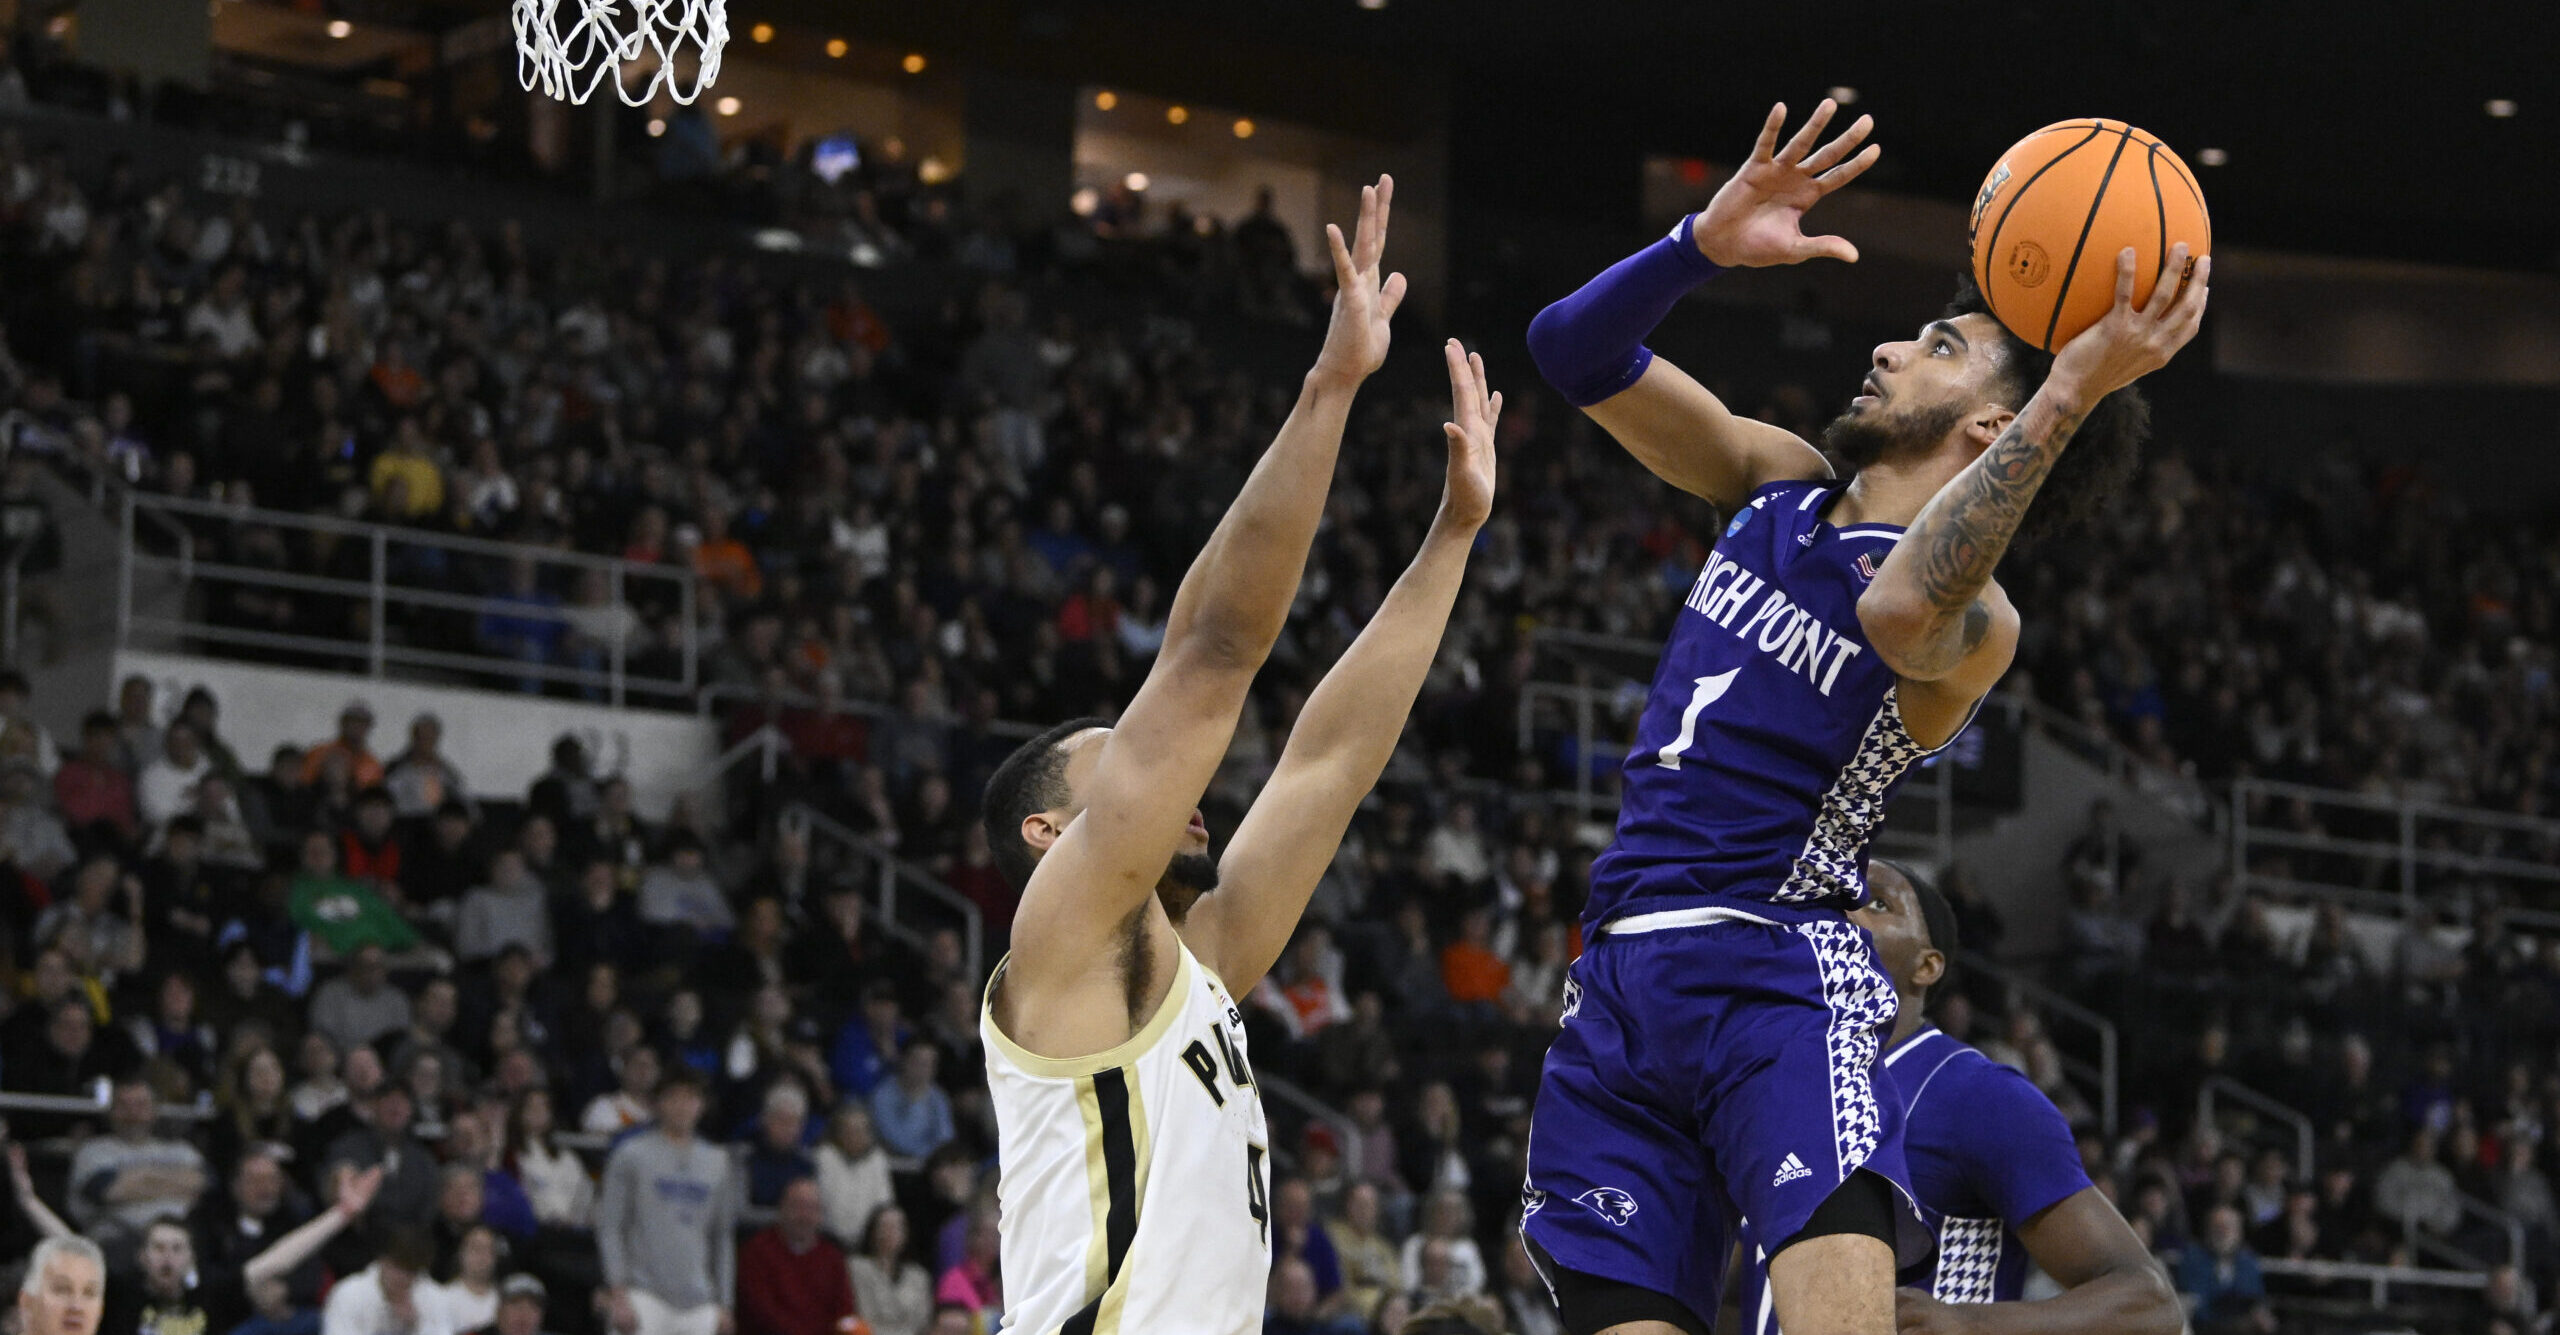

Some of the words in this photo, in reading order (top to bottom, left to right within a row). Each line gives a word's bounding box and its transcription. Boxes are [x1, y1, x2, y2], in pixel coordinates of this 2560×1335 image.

[1685, 549, 1766, 630] HIGH
[1736, 588, 1862, 698] POINT
[1657, 667, 1741, 771] 1
[1180, 1021, 1258, 1109] PU
[1246, 1142, 1268, 1252] 4
[1773, 1168, 1812, 1187] adidas
